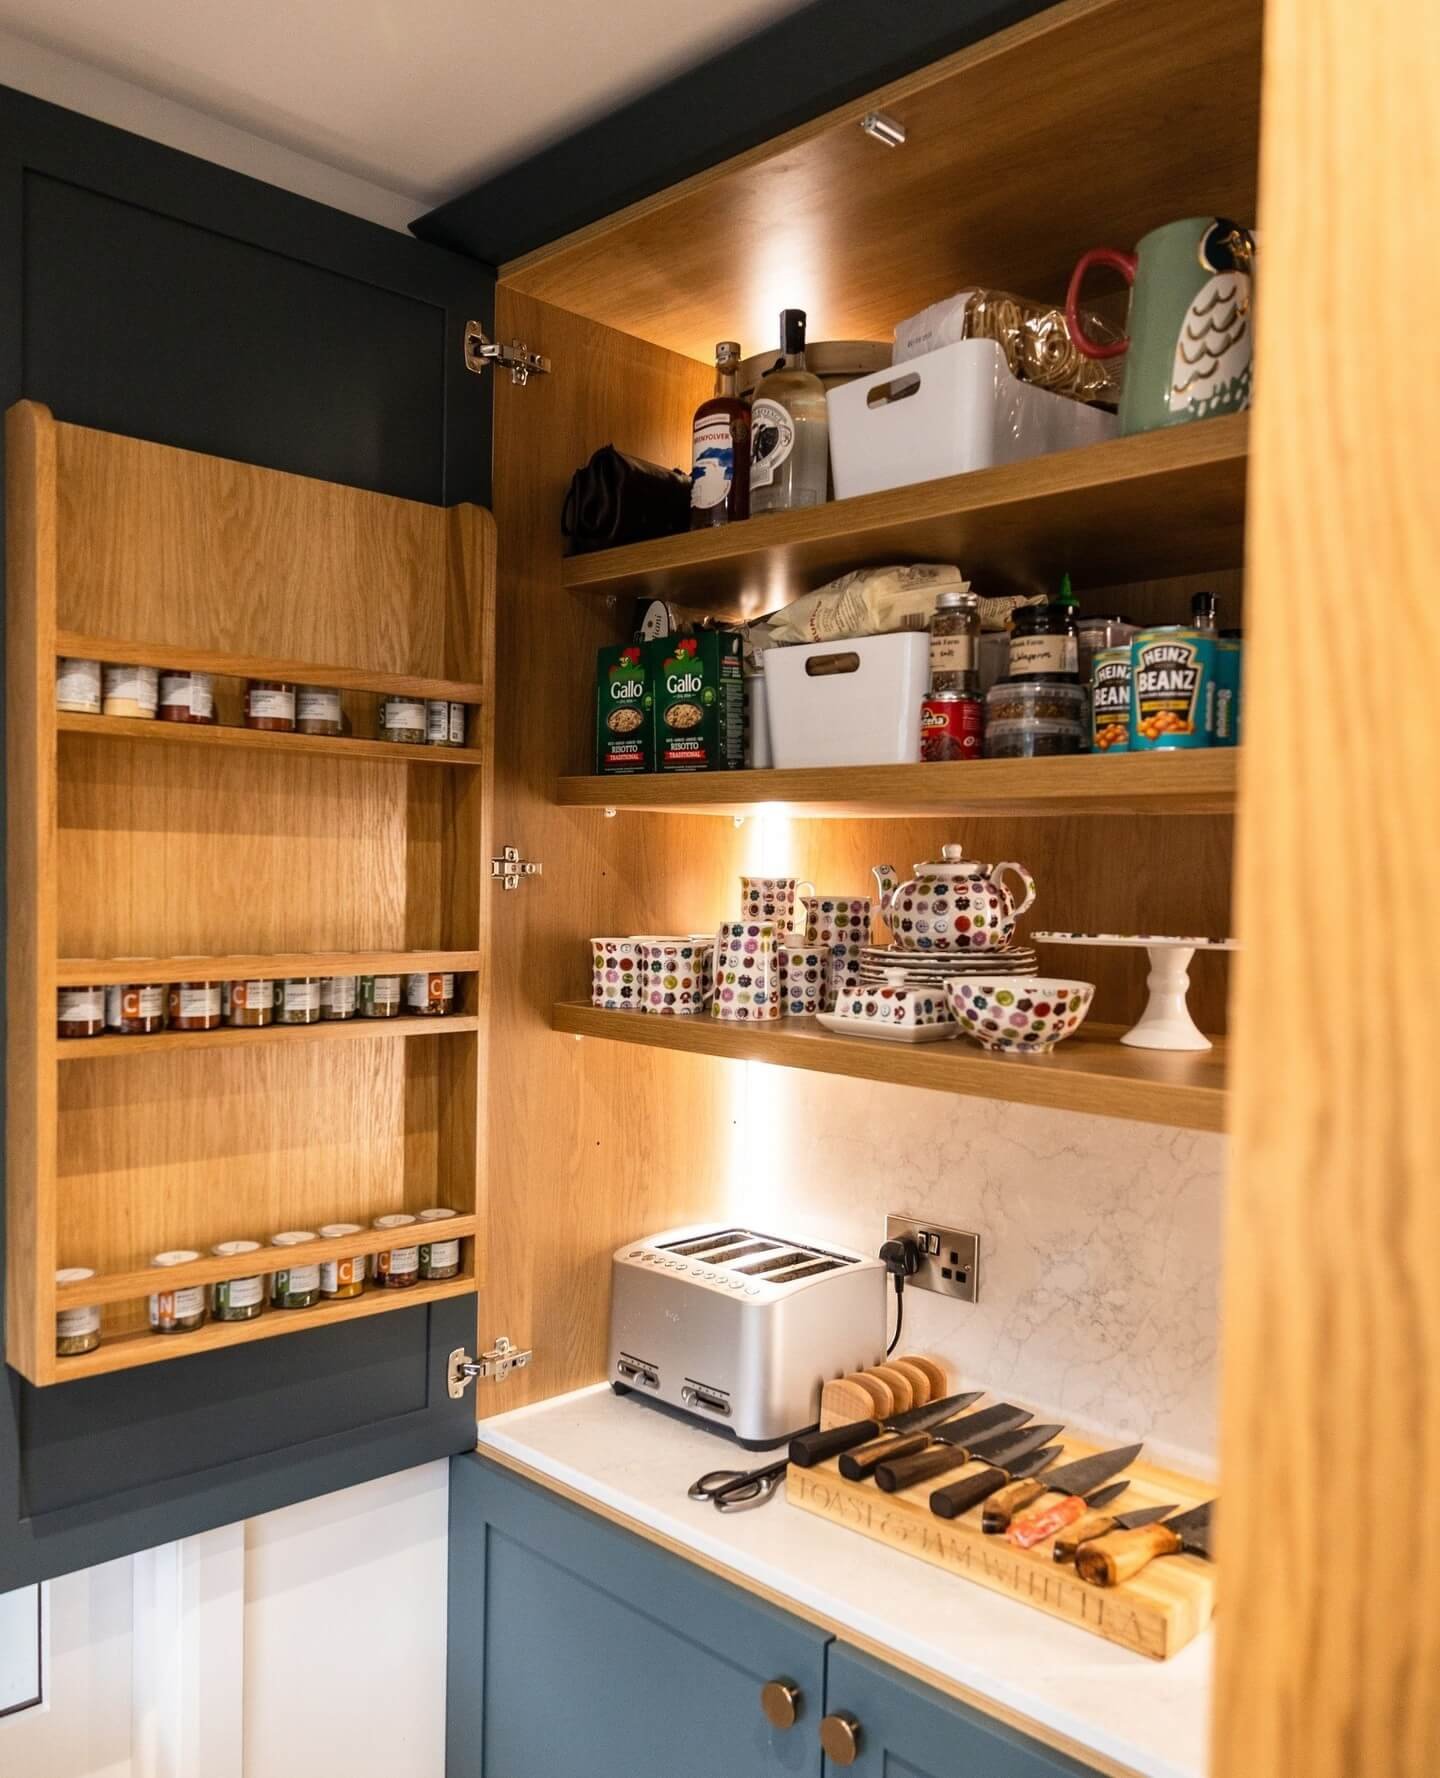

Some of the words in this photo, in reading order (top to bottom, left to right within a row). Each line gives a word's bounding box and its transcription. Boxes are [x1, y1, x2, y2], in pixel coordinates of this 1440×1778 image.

[1144, 647, 1189, 664] HEINZ
[666, 673, 702, 693] Gallo
[1139, 669, 1195, 691] BEANZ
[610, 680, 643, 699] Gallo
[1094, 686, 1130, 706] BEAN
[612, 745, 638, 754] RISOTTO
[670, 742, 699, 751] RISOTTO
[233, 986, 244, 1004] C
[362, 982, 371, 998] T
[431, 979, 441, 995] C
[124, 994, 137, 1012] C
[379, 1253, 388, 1269] C
[420, 1247, 430, 1263] S
[340, 1263, 351, 1280] C
[278, 1272, 288, 1289] P
[160, 1296, 172, 1313] N
[793, 1473, 872, 1528] TOAST
